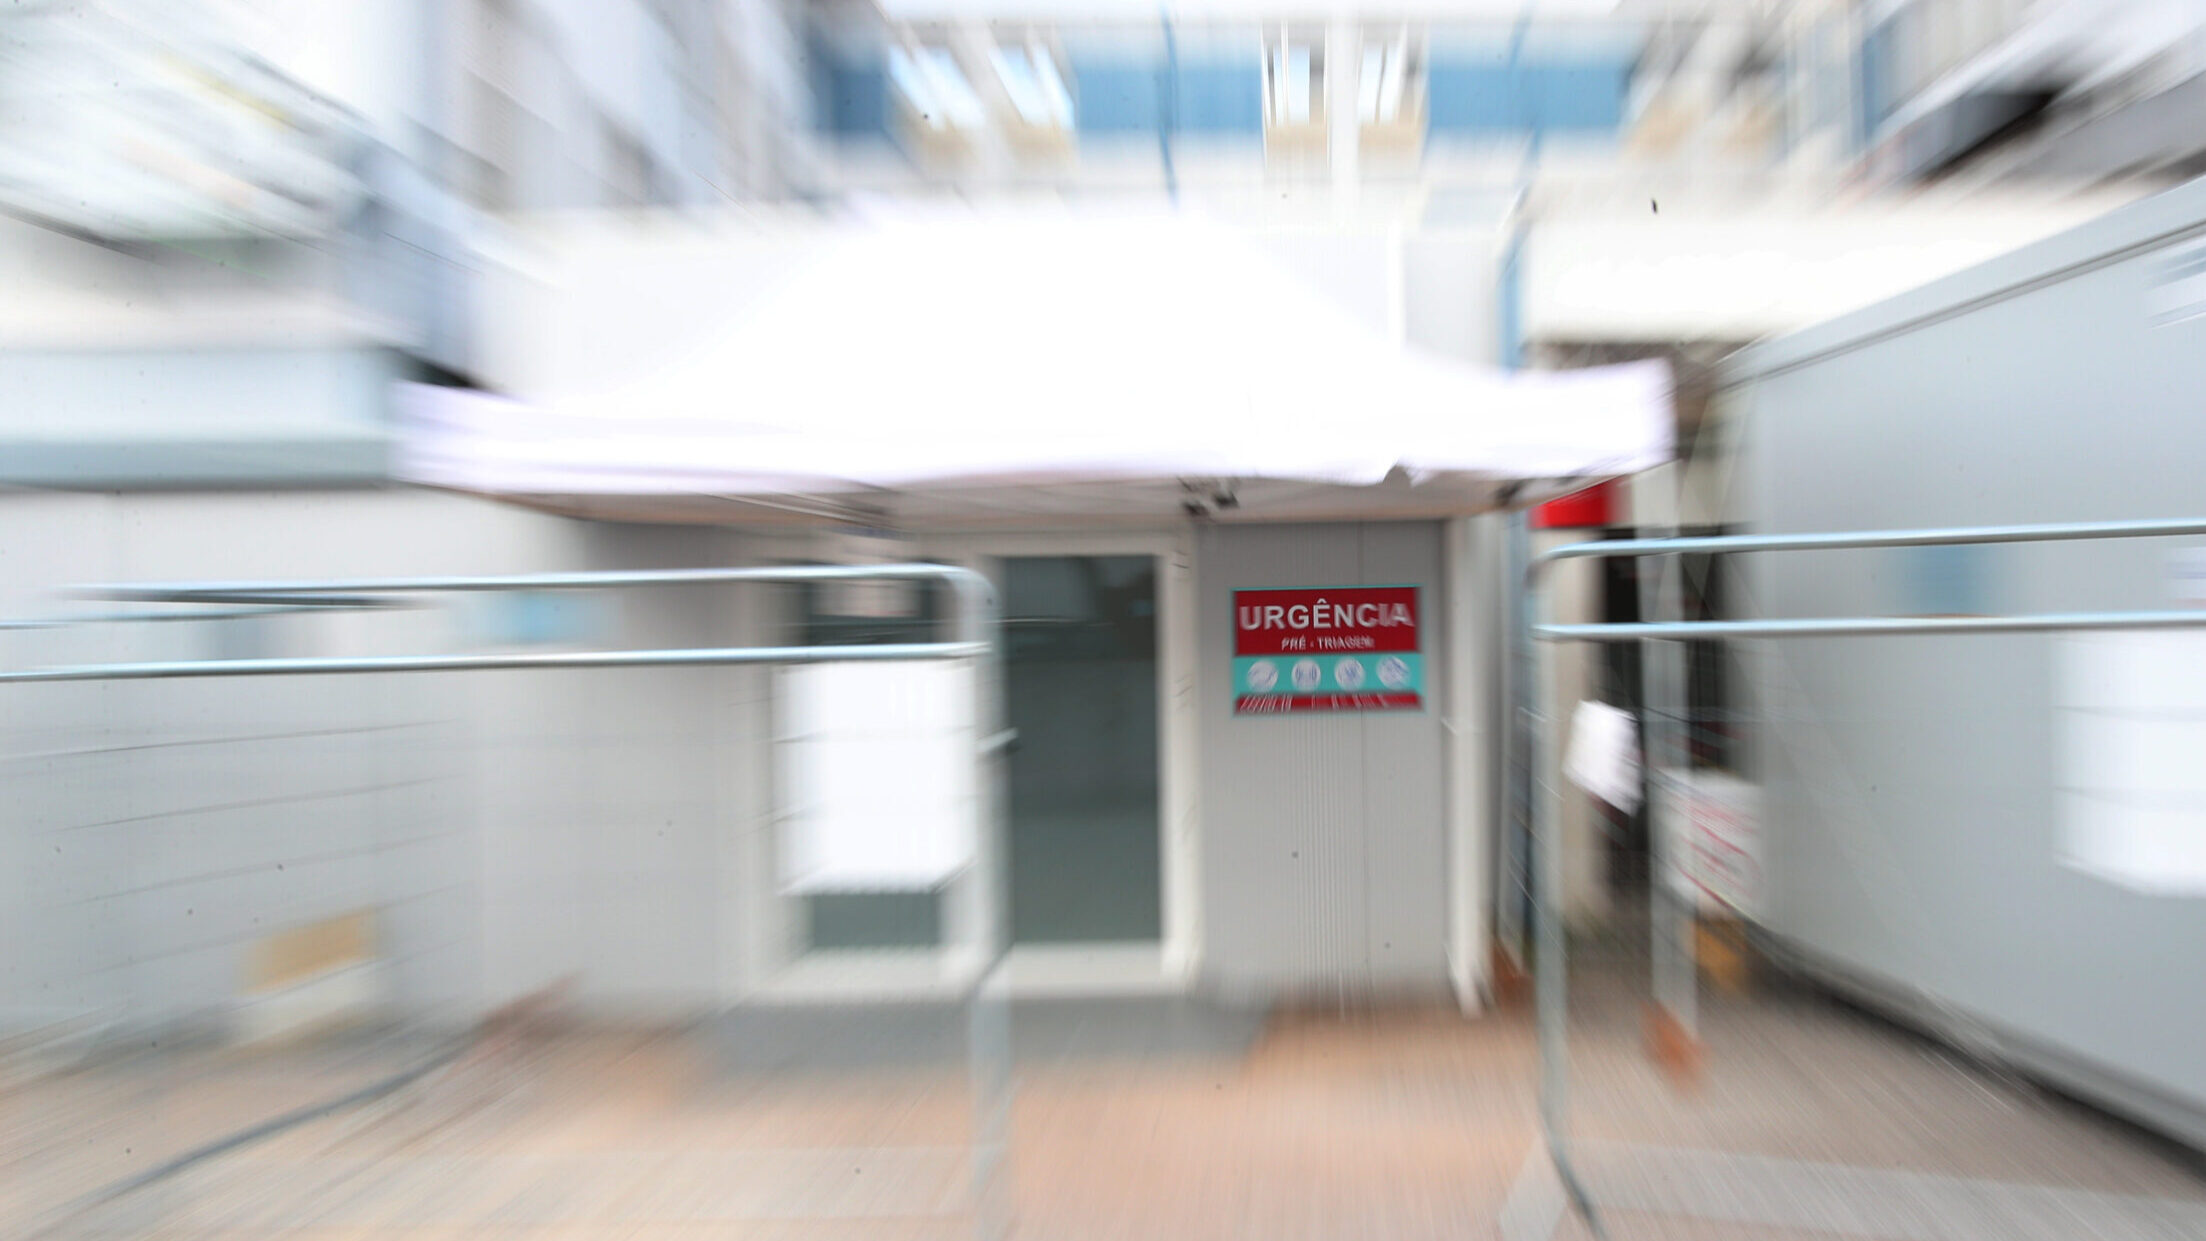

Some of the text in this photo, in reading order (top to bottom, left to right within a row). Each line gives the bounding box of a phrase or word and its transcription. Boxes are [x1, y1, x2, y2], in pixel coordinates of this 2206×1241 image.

[1239, 598, 1415, 631] URGÊNCIA
[1281, 634, 1306, 650] PRÉ
[1317, 635, 1375, 650] TRIAGEM
